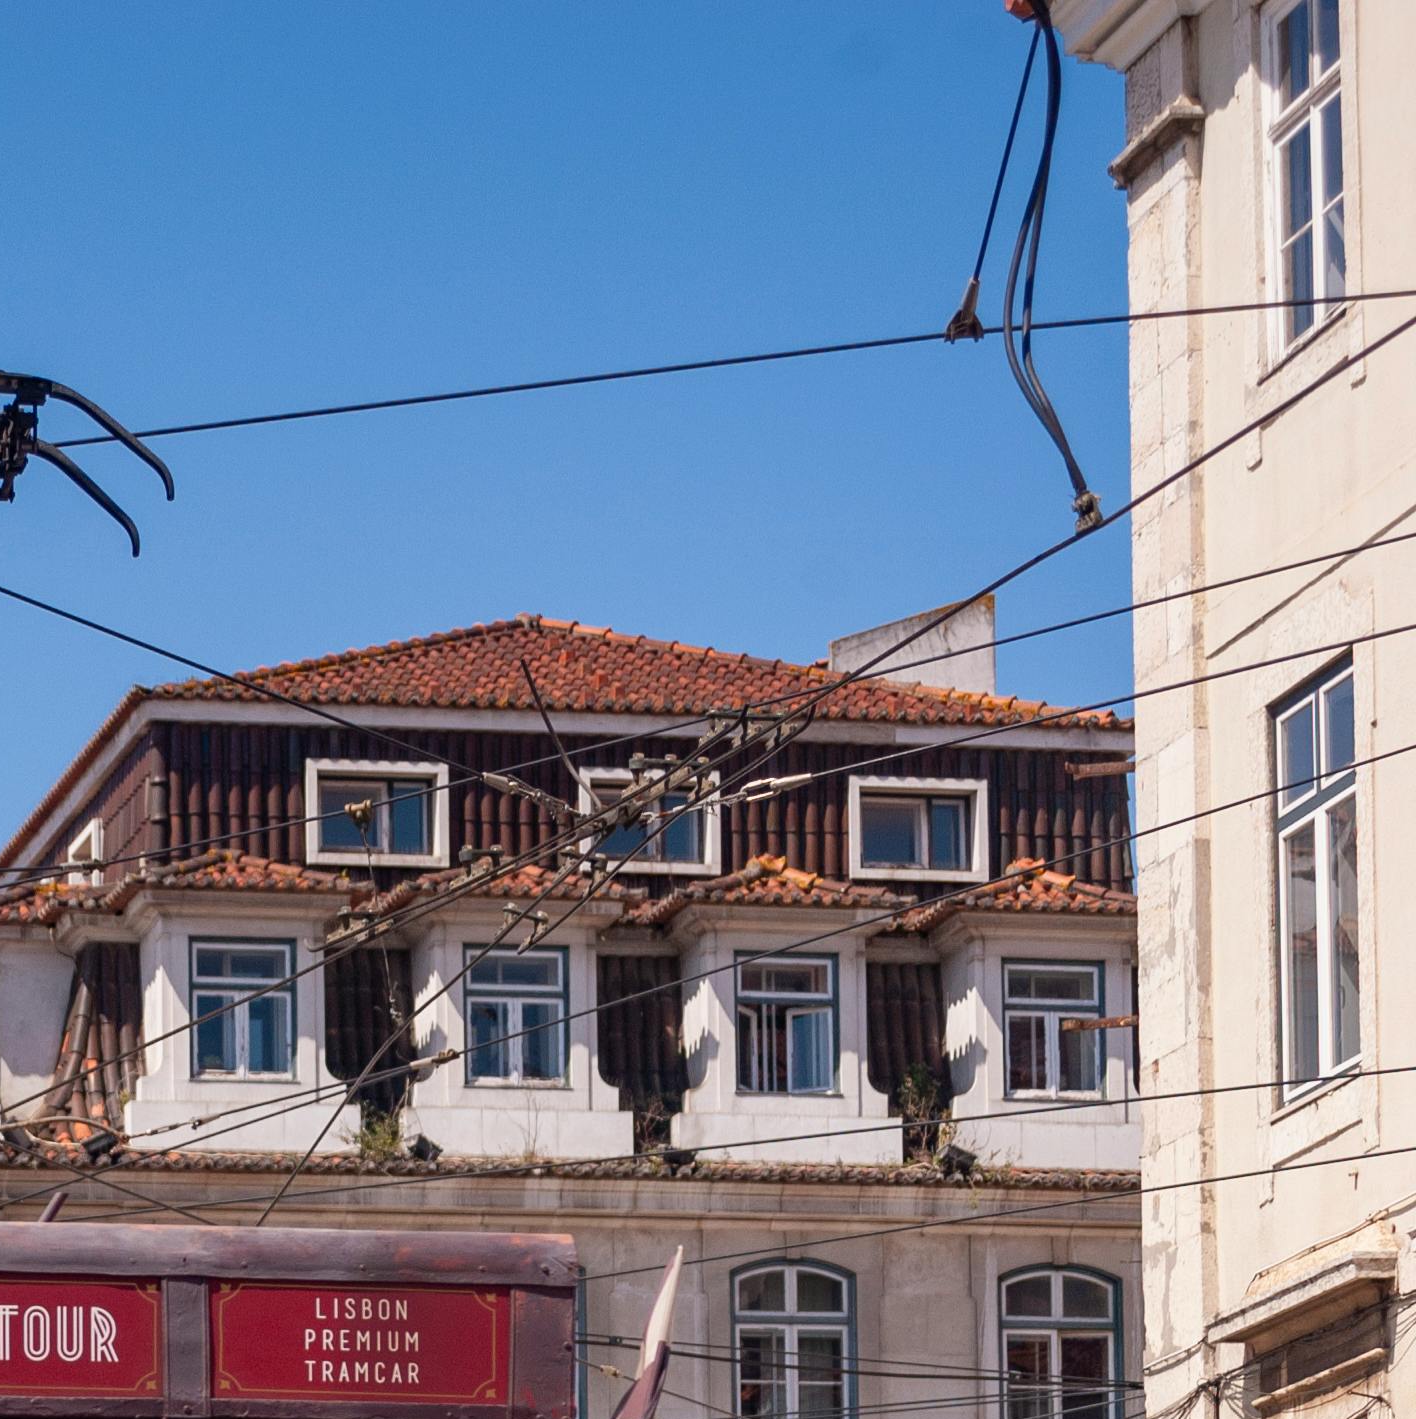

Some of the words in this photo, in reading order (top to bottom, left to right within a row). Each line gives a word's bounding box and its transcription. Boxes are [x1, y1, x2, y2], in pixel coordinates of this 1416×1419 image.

[315, 1297, 408, 1320] LISBON
[304, 1328, 419, 1352] PREMIUM
[304, 1360, 420, 1384] TRAMCAR
